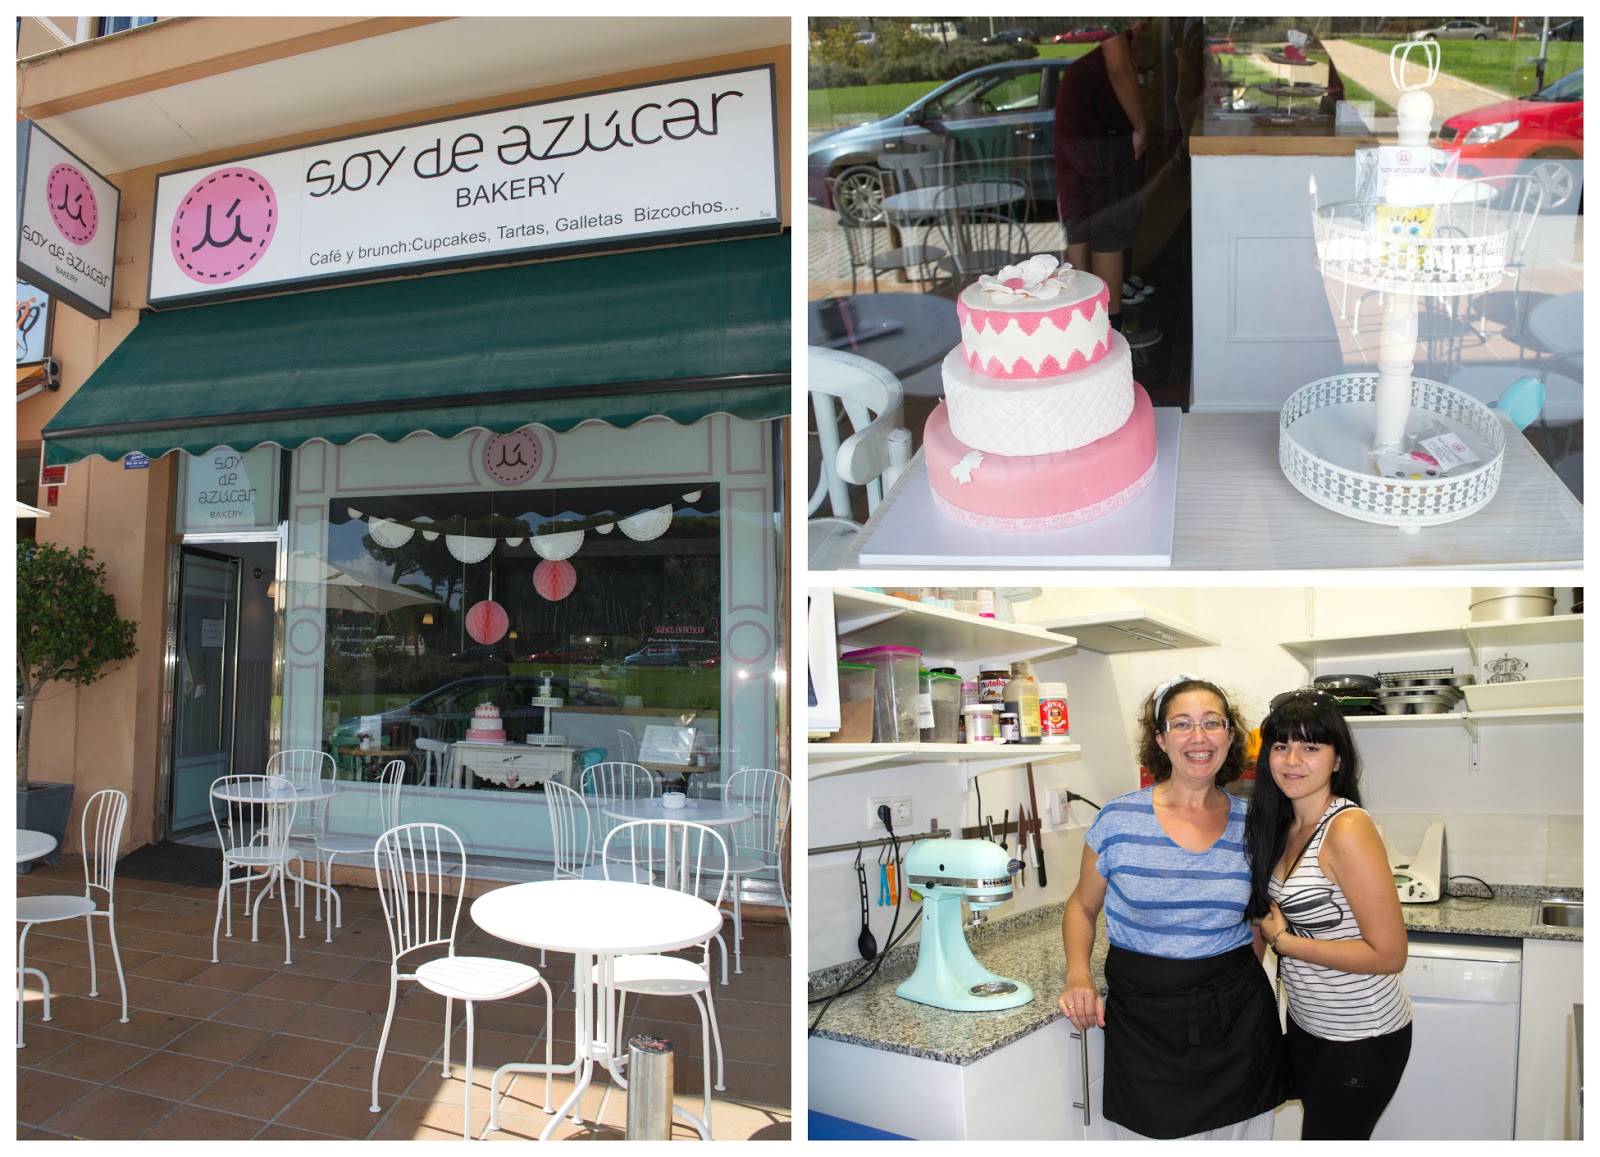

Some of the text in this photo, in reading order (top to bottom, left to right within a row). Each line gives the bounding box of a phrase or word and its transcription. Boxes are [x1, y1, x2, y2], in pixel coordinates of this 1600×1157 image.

[306, 90, 744, 198] soy de azúcar
[456, 172, 566, 208] BAKERY
[309, 249, 342, 266] Café
[346, 250, 354, 264] y
[496, 223, 549, 240] Tartas,
[555, 213, 624, 232] Galletas
[22, 225, 111, 288] soy de azúcar
[55, 265, 79, 284] BAKERY
[214, 456, 243, 470] soy
[218, 472, 238, 486] de
[198, 488, 257, 504] azúcar
[210, 510, 243, 519] BAKERY
[982, 678, 1006, 688] nutella
[1043, 701, 1065, 712] ROYAL
